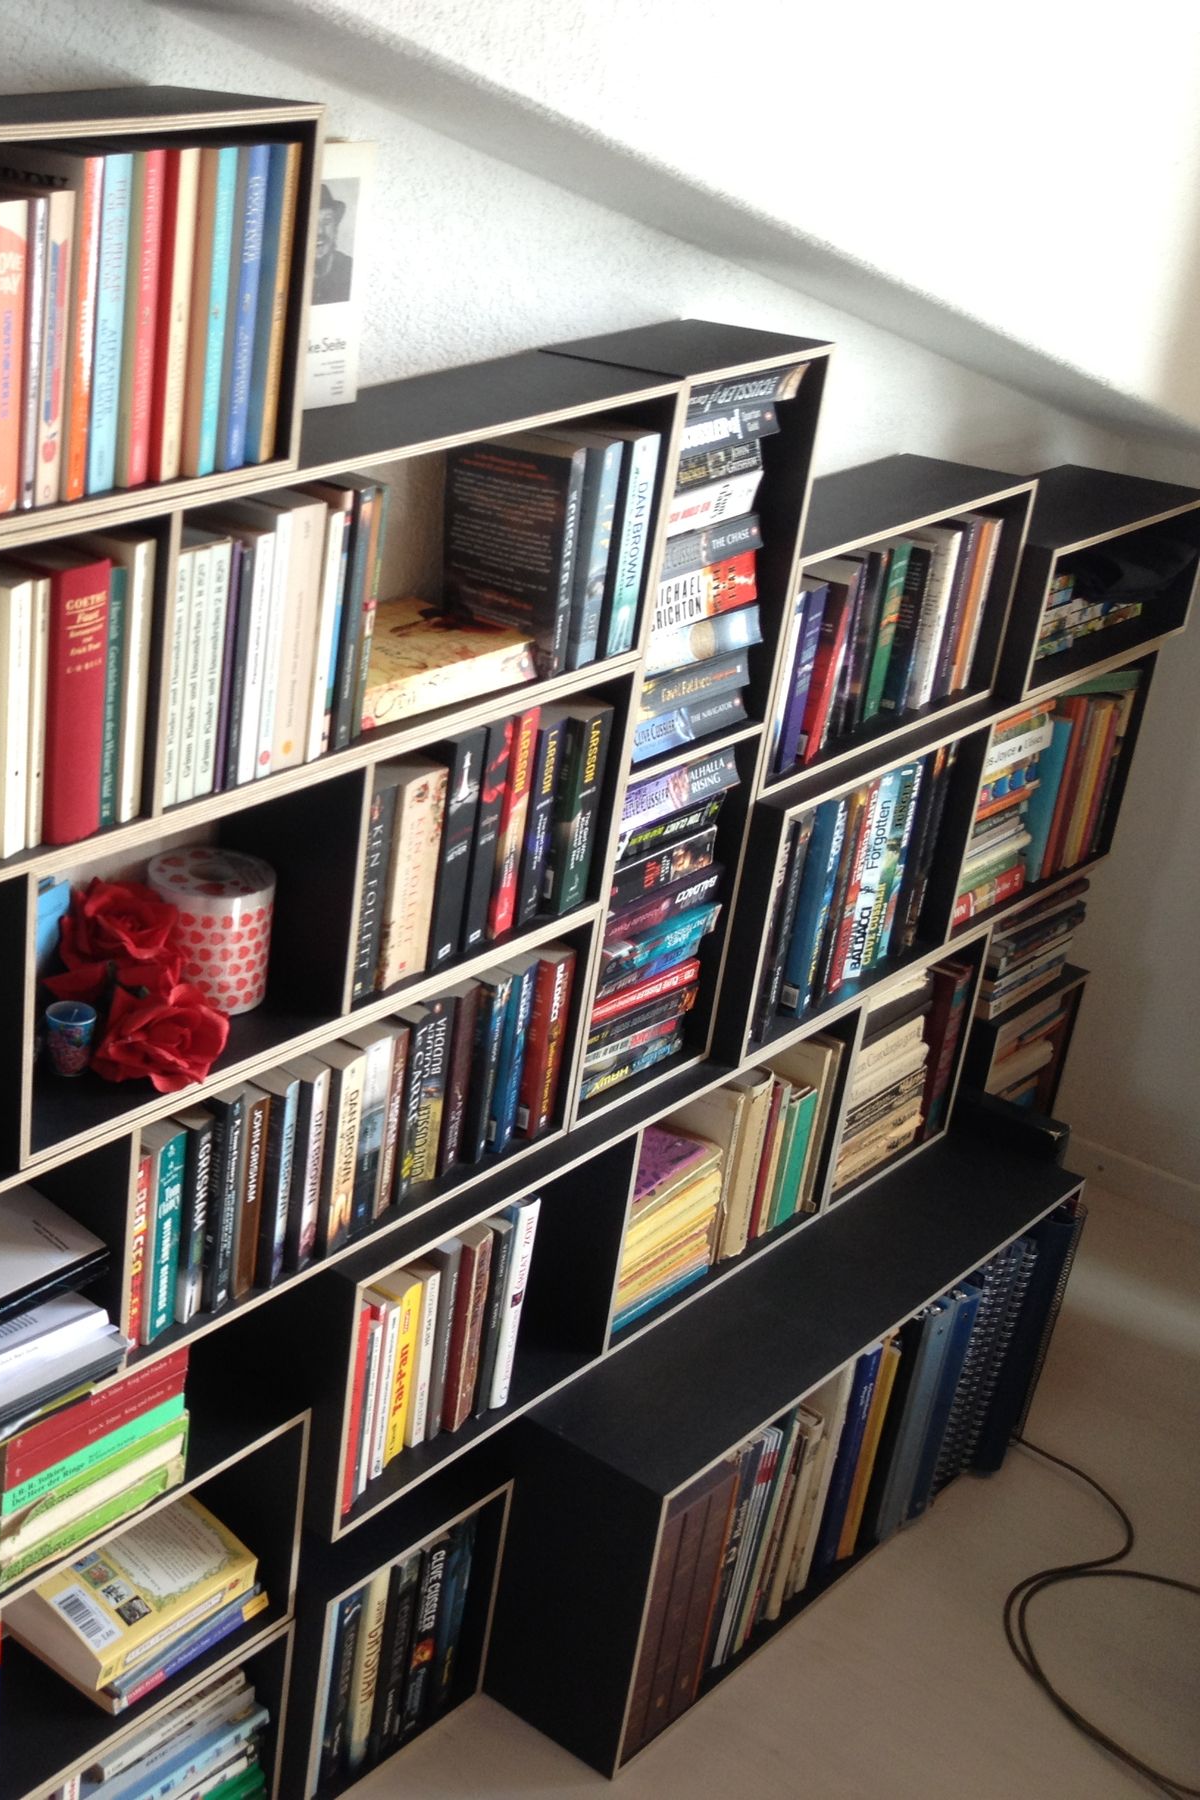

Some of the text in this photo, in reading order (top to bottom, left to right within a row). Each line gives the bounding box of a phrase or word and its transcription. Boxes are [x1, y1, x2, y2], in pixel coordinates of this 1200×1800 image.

[0, 272, 22, 295] DAY
[104, 324, 118, 408] ALEXANDER
[557, 505, 578, 590] CUSSLER
[625, 482, 649, 590] DAN BROWN
[711, 527, 751, 552] THE CHASE
[552, 614, 565, 650] Medusa
[101, 600, 122, 798] Horváth Geschichten Wiener Wald
[182, 609, 204, 778] Grimm Hausmärchen
[201, 606, 222, 775] Grimm Hausmärchen
[690, 701, 734, 724] THE NAVIGATOR
[513, 717, 533, 794] LARSSON
[541, 729, 559, 795] LARSSON
[584, 719, 603, 784] LARSSON
[650, 718, 676, 741] CUSSLER
[685, 757, 725, 787] VALHALLA
[691, 772, 721, 794] RISING
[864, 788, 878, 821] CLIVE
[895, 783, 913, 828] JUNGLE
[866, 799, 893, 871] Forgotten
[900, 764, 923, 848] CLIVE CUSSLER
[357, 823, 384, 969] KEN FOLLETT
[403, 815, 425, 943] KEN FOLLETT
[676, 874, 719, 904] BALDACCI
[849, 905, 873, 972] BALDACCI
[861, 882, 887, 966] CLIVE CUSSLER
[516, 973, 530, 1036] BALDACCI
[550, 963, 565, 1023] BALDACCI
[431, 1016, 448, 1076] BUDDHA
[247, 1108, 265, 1203] JOHN GRISHAM
[280, 1121, 295, 1219] DAN BROWN
[308, 1108, 325, 1208] DAN BROWN
[341, 1087, 361, 1187] DAN BROWN
[410, 1102, 432, 1180] CLIVE CUSSLER
[192, 1142, 213, 1232] GRISHAM
[158, 1216, 173, 1263] WITHOUT
[523, 1216, 535, 1248] ZOFII
[155, 1265, 170, 1315] REMORSE
[424, 1320, 433, 1348] POLISH
[391, 1343, 410, 1418] Tai-Pan
[11, 1461, 86, 1508] Der Herr der Ringe
[37, 1466, 67, 1485] Tolkien
[421, 1549, 446, 1632] CLIVE CUSSLER
[359, 1627, 383, 1705] GRISHAM
